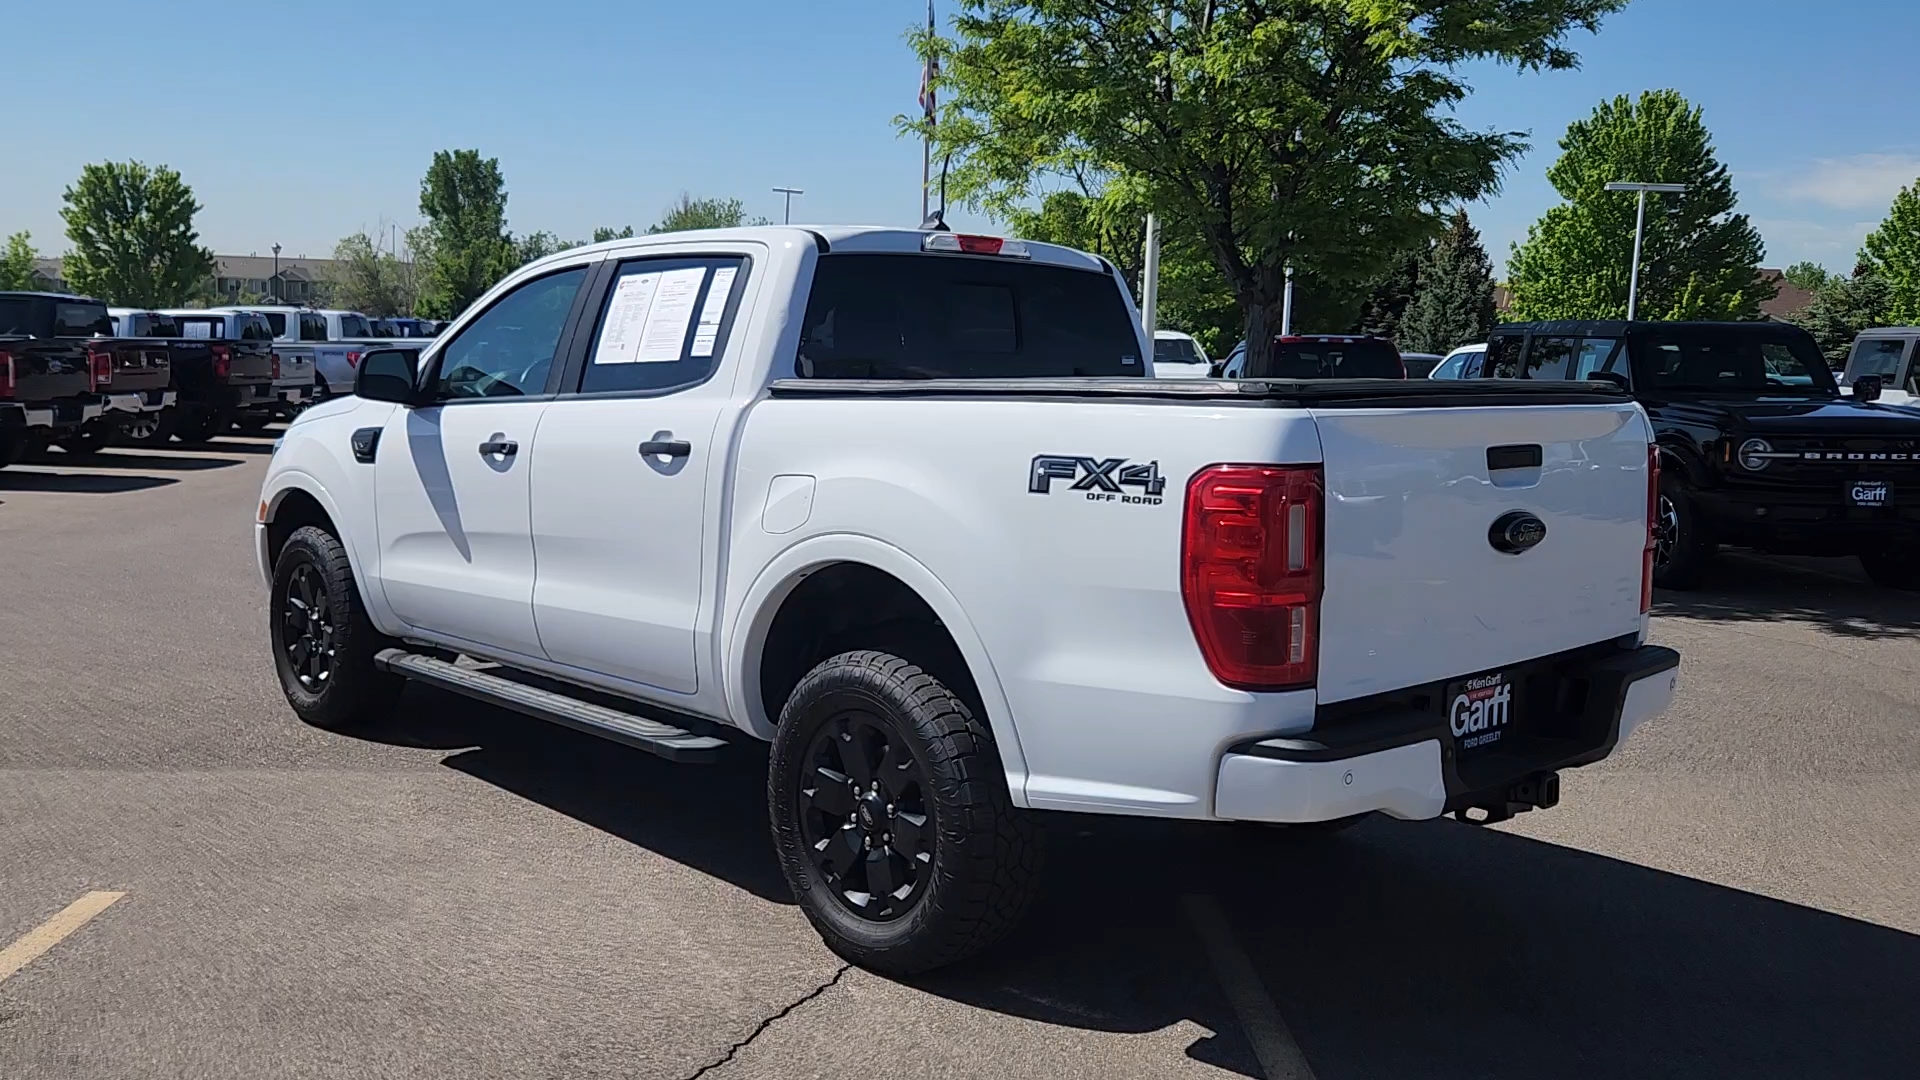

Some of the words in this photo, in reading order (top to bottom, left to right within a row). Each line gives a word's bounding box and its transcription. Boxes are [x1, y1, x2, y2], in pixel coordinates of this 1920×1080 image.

[1028, 454, 1167, 497] FX4
[1086, 492, 1117, 502] OFF
[1121, 494, 1163, 506] ROAD
[1851, 487, 1887, 501] Garff
[1450, 683, 1511, 737] Garff
